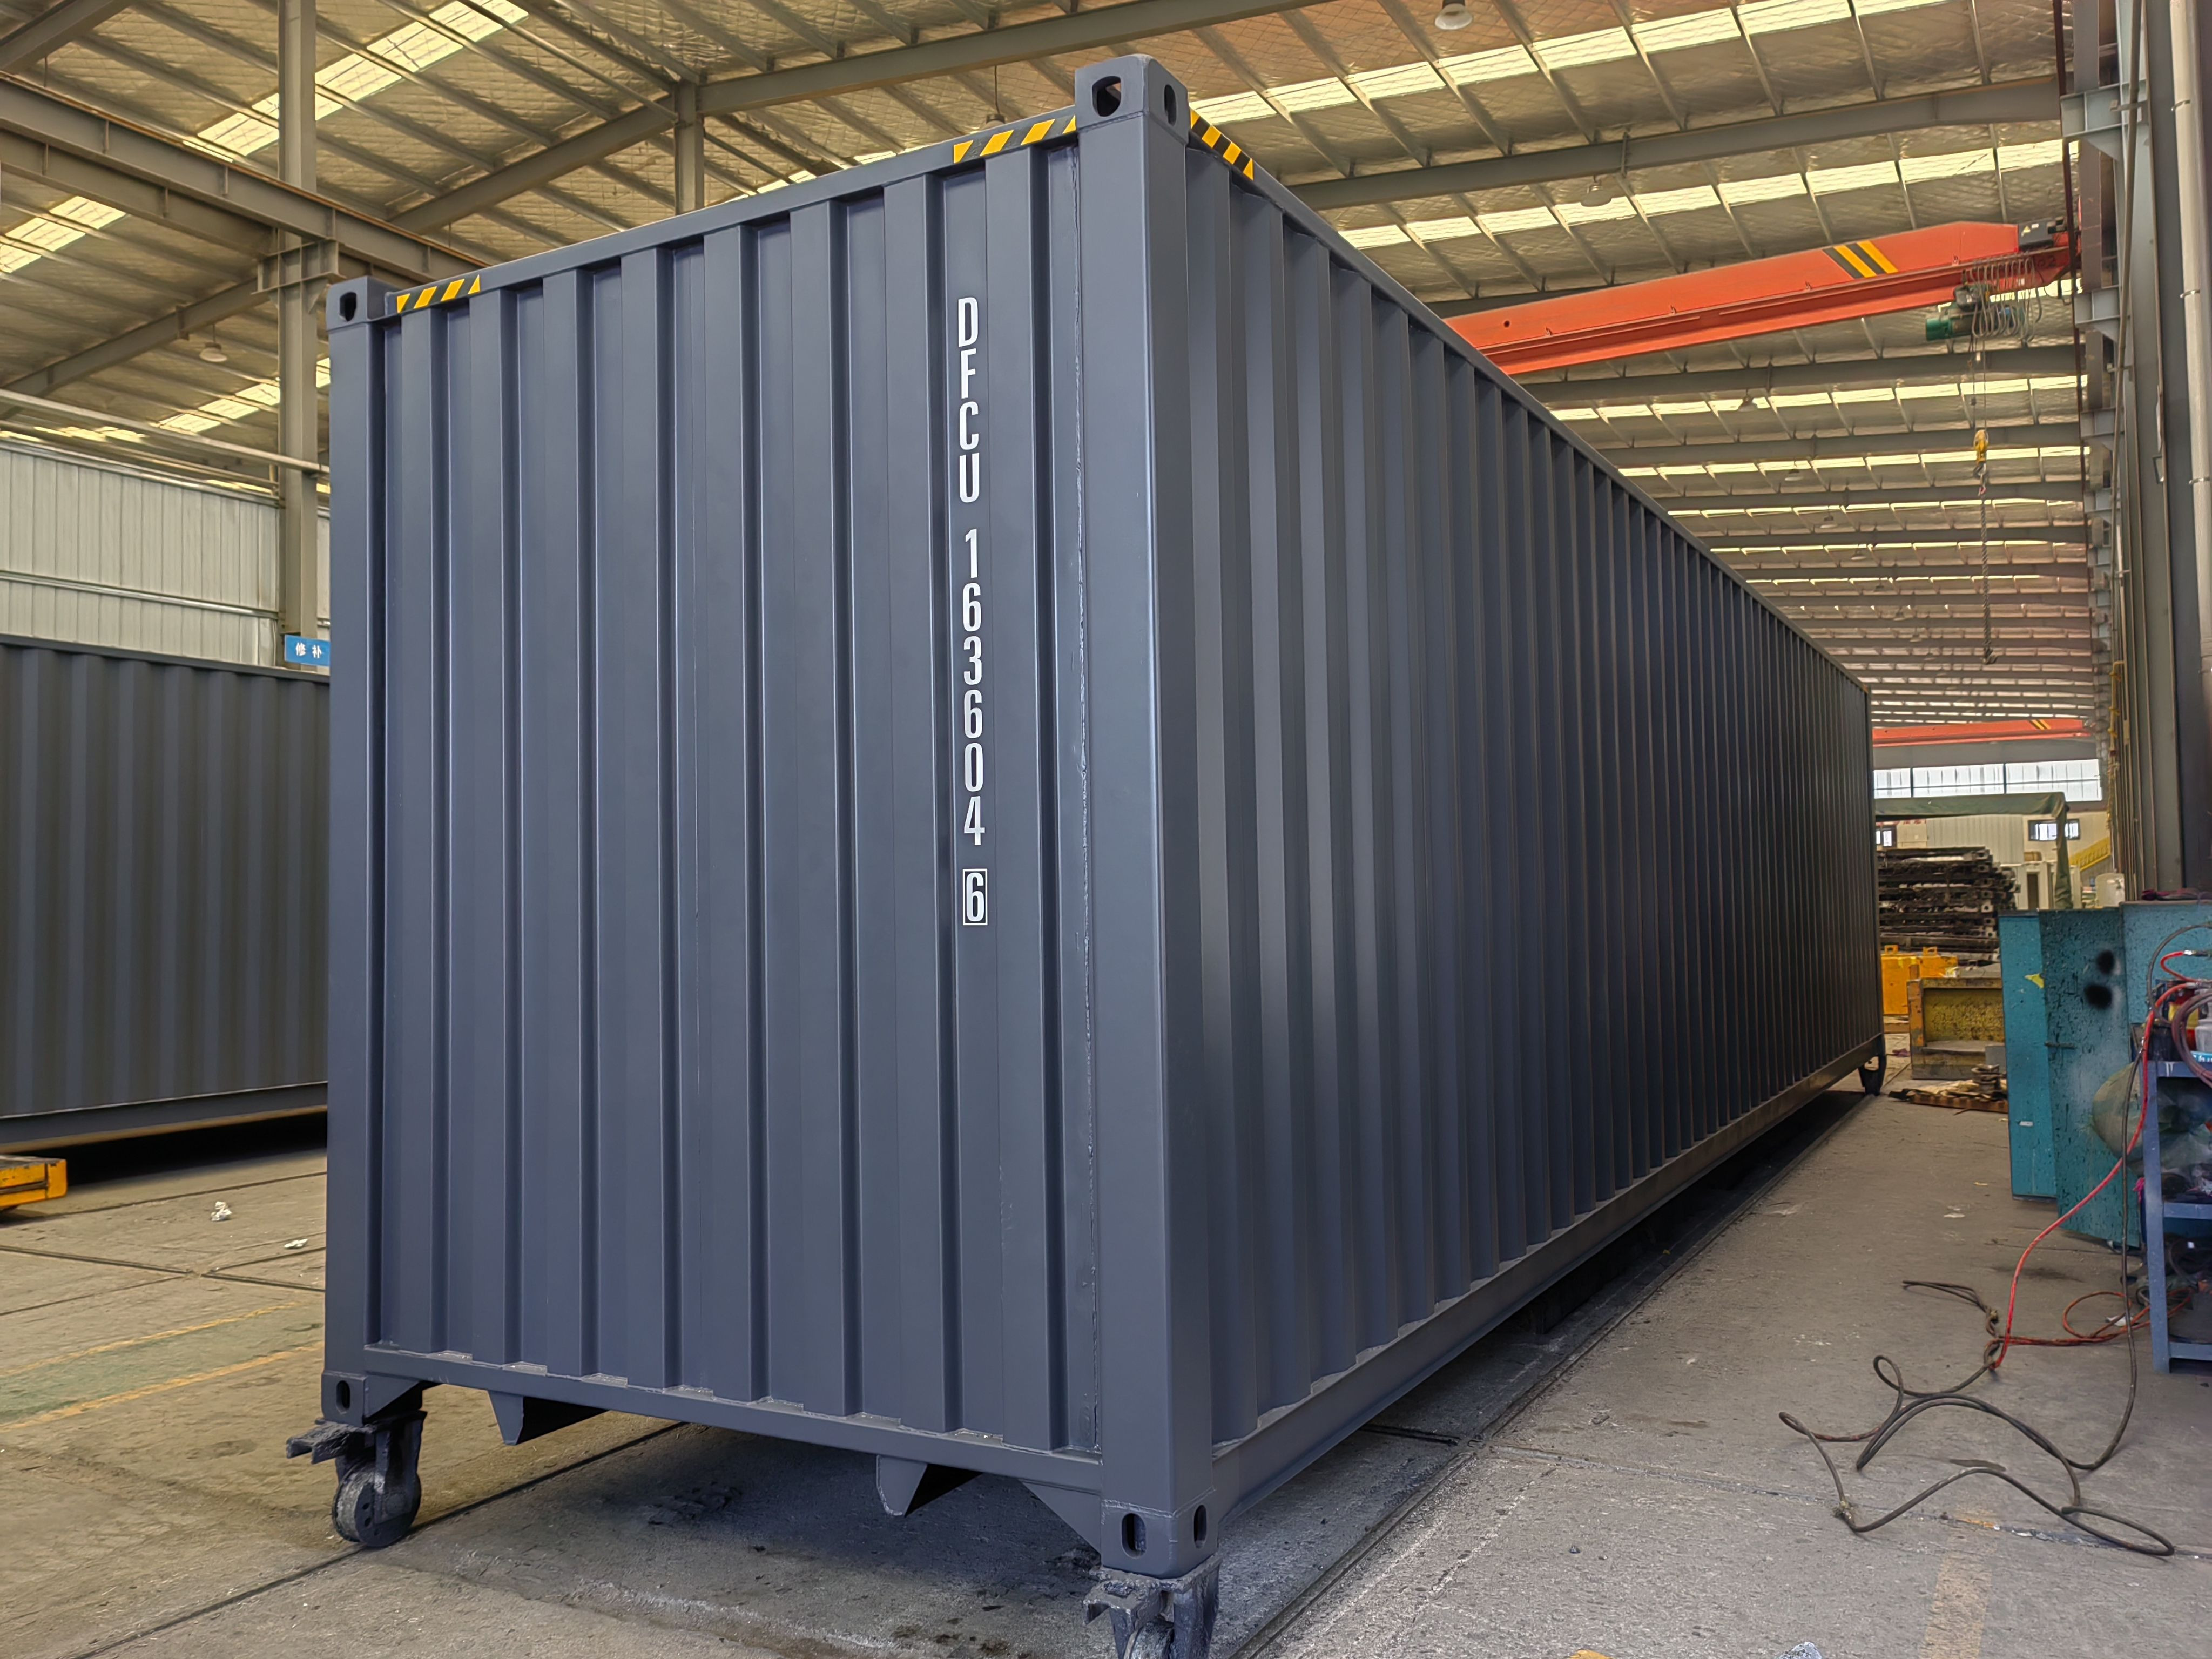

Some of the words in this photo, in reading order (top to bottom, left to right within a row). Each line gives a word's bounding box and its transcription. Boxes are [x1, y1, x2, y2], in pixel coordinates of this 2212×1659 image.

[958, 296, 980, 503] DFCU
[962, 529, 986, 846] 163604
[966, 872, 985, 922] 6
